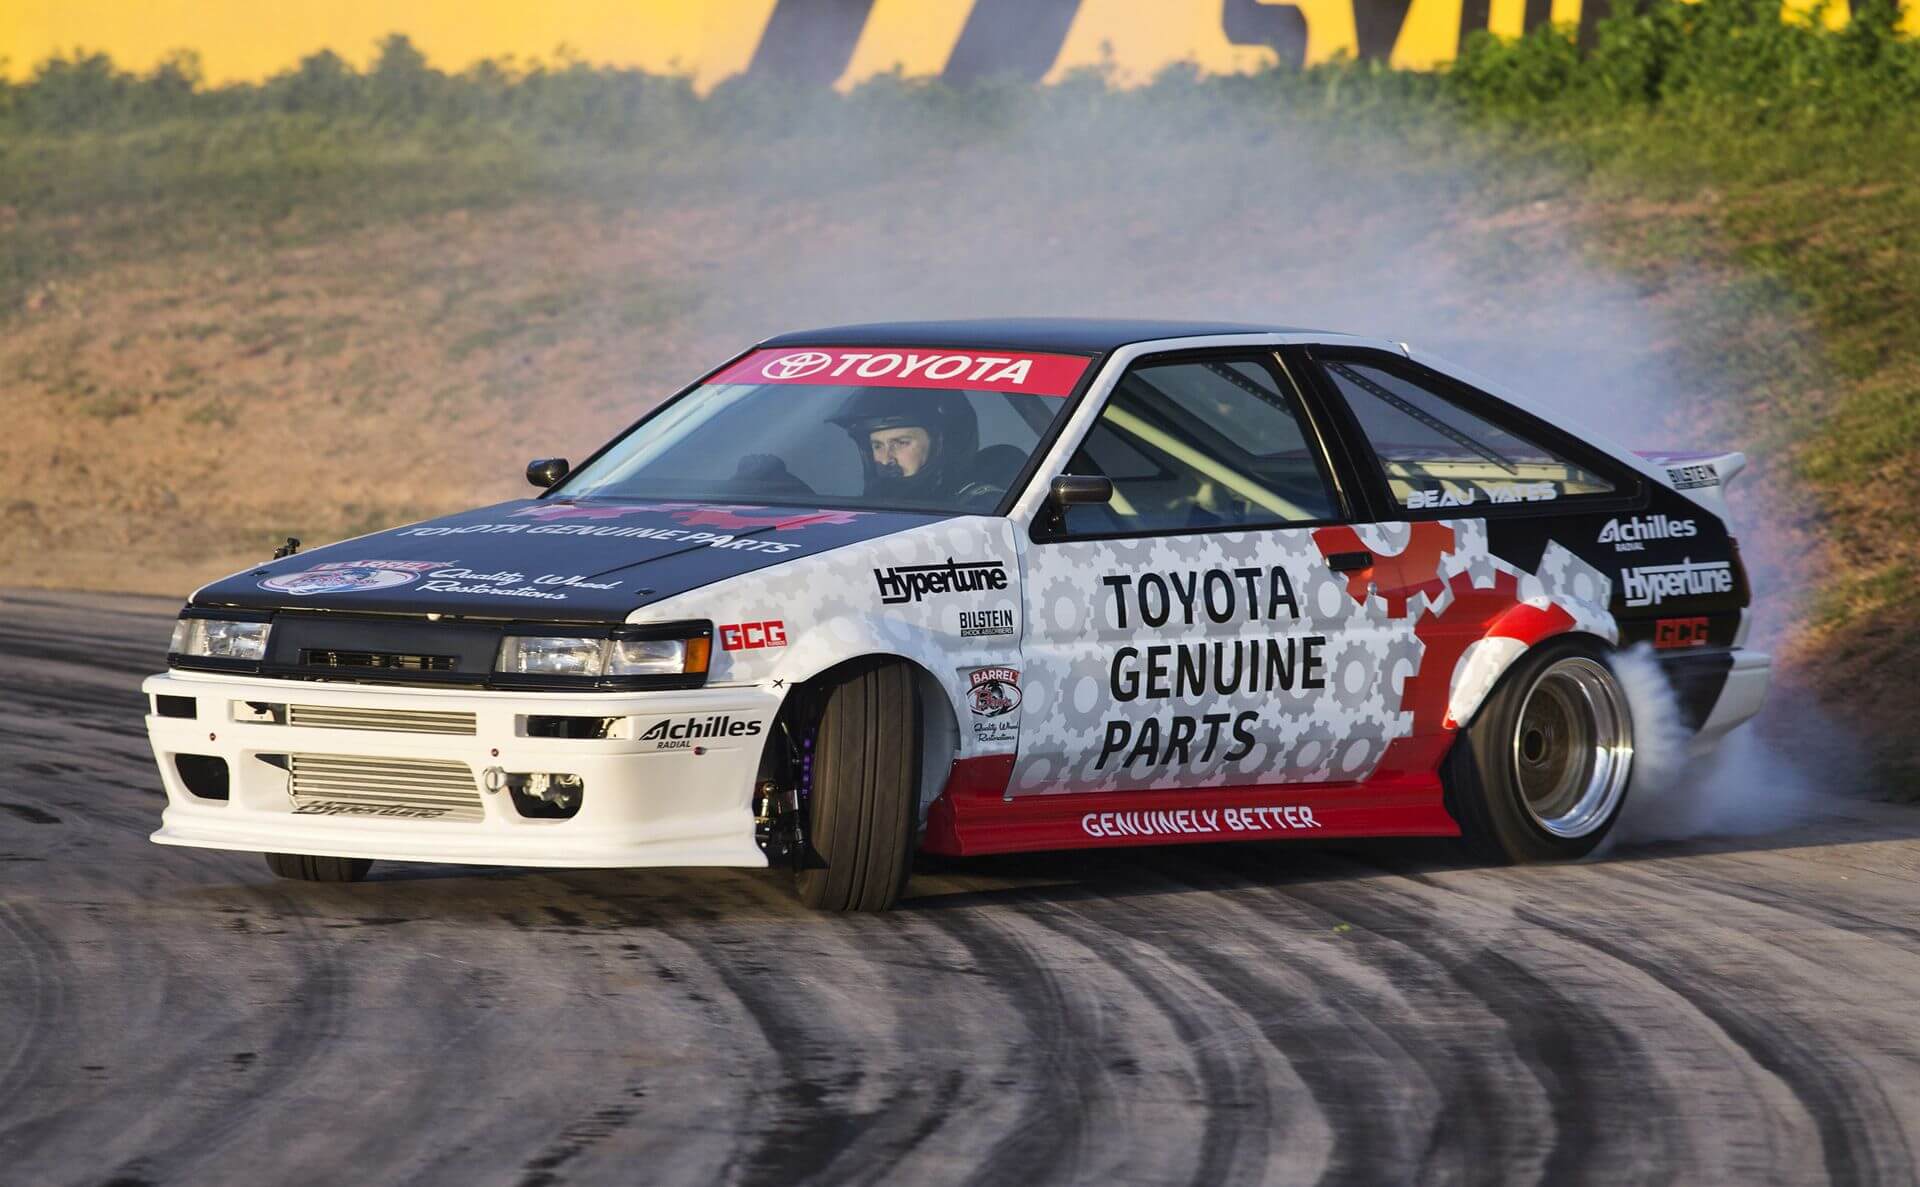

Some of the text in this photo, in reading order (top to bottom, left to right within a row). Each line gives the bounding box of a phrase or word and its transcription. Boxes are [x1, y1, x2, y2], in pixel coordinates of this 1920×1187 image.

[831, 354, 1033, 384] TOYOTA
[1407, 488, 1474, 509] BEAU
[397, 524, 802, 553] TOYOTA GENUINE PARTS
[1597, 515, 1697, 543] Achilles
[416, 580, 568, 600] Restorations
[429, 568, 623, 590] Quality Wheel
[874, 556, 1008, 604] Hypertune
[1620, 556, 1733, 607] Hypertune
[1103, 566, 1300, 629] TOYOTA
[959, 610, 1013, 629] BILSTEIN
[1654, 617, 1709, 649] GCG
[719, 621, 788, 651] GCG
[973, 671, 1016, 685] BARREL
[1110, 636, 1326, 702] GENUINE
[638, 716, 761, 741] Achilles
[1094, 711, 1260, 770] PARTS
[656, 741, 691, 749] RADIAL
[1082, 806, 1321, 837] GENUINELY BETTER
